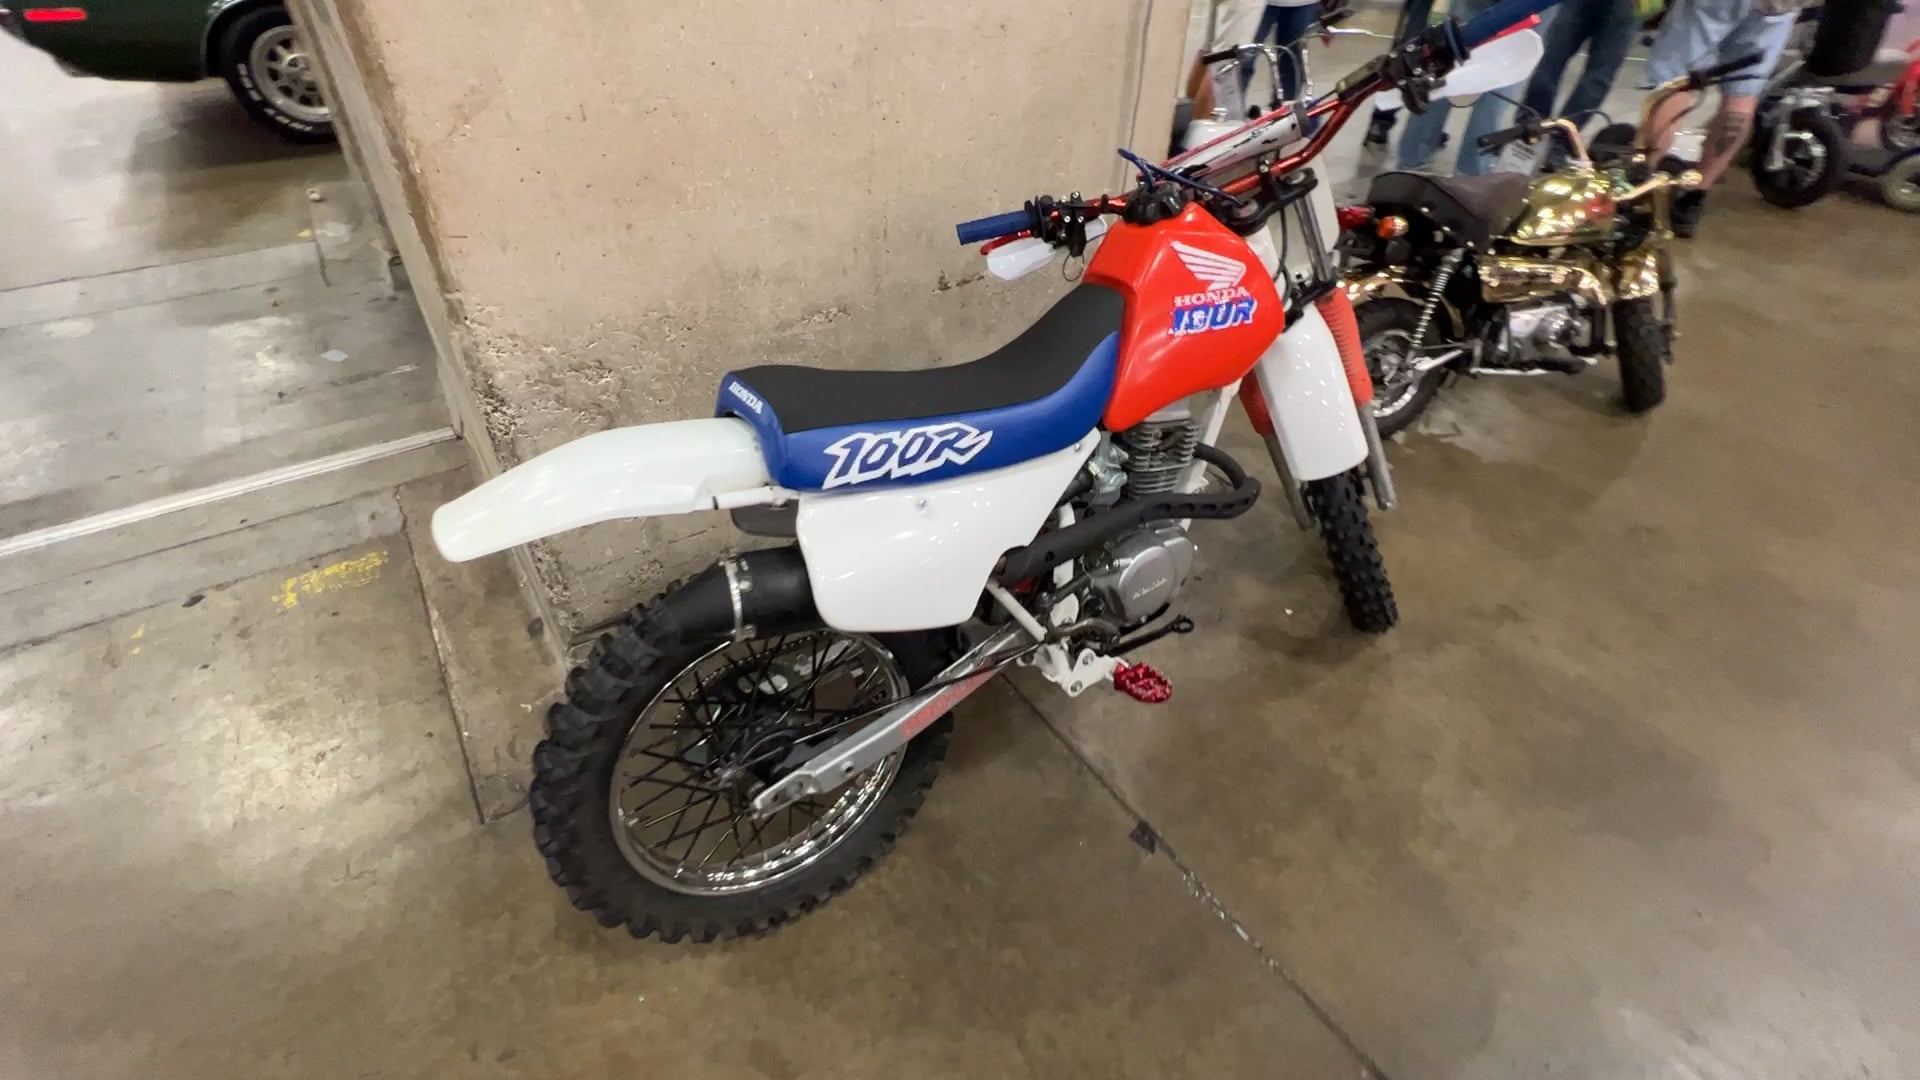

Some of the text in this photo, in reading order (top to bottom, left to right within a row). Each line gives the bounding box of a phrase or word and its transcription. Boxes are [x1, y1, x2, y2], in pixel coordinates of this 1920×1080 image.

[1174, 287, 1250, 307] HONDA
[728, 381, 763, 414] HONDA
[822, 422, 993, 490] 100R
